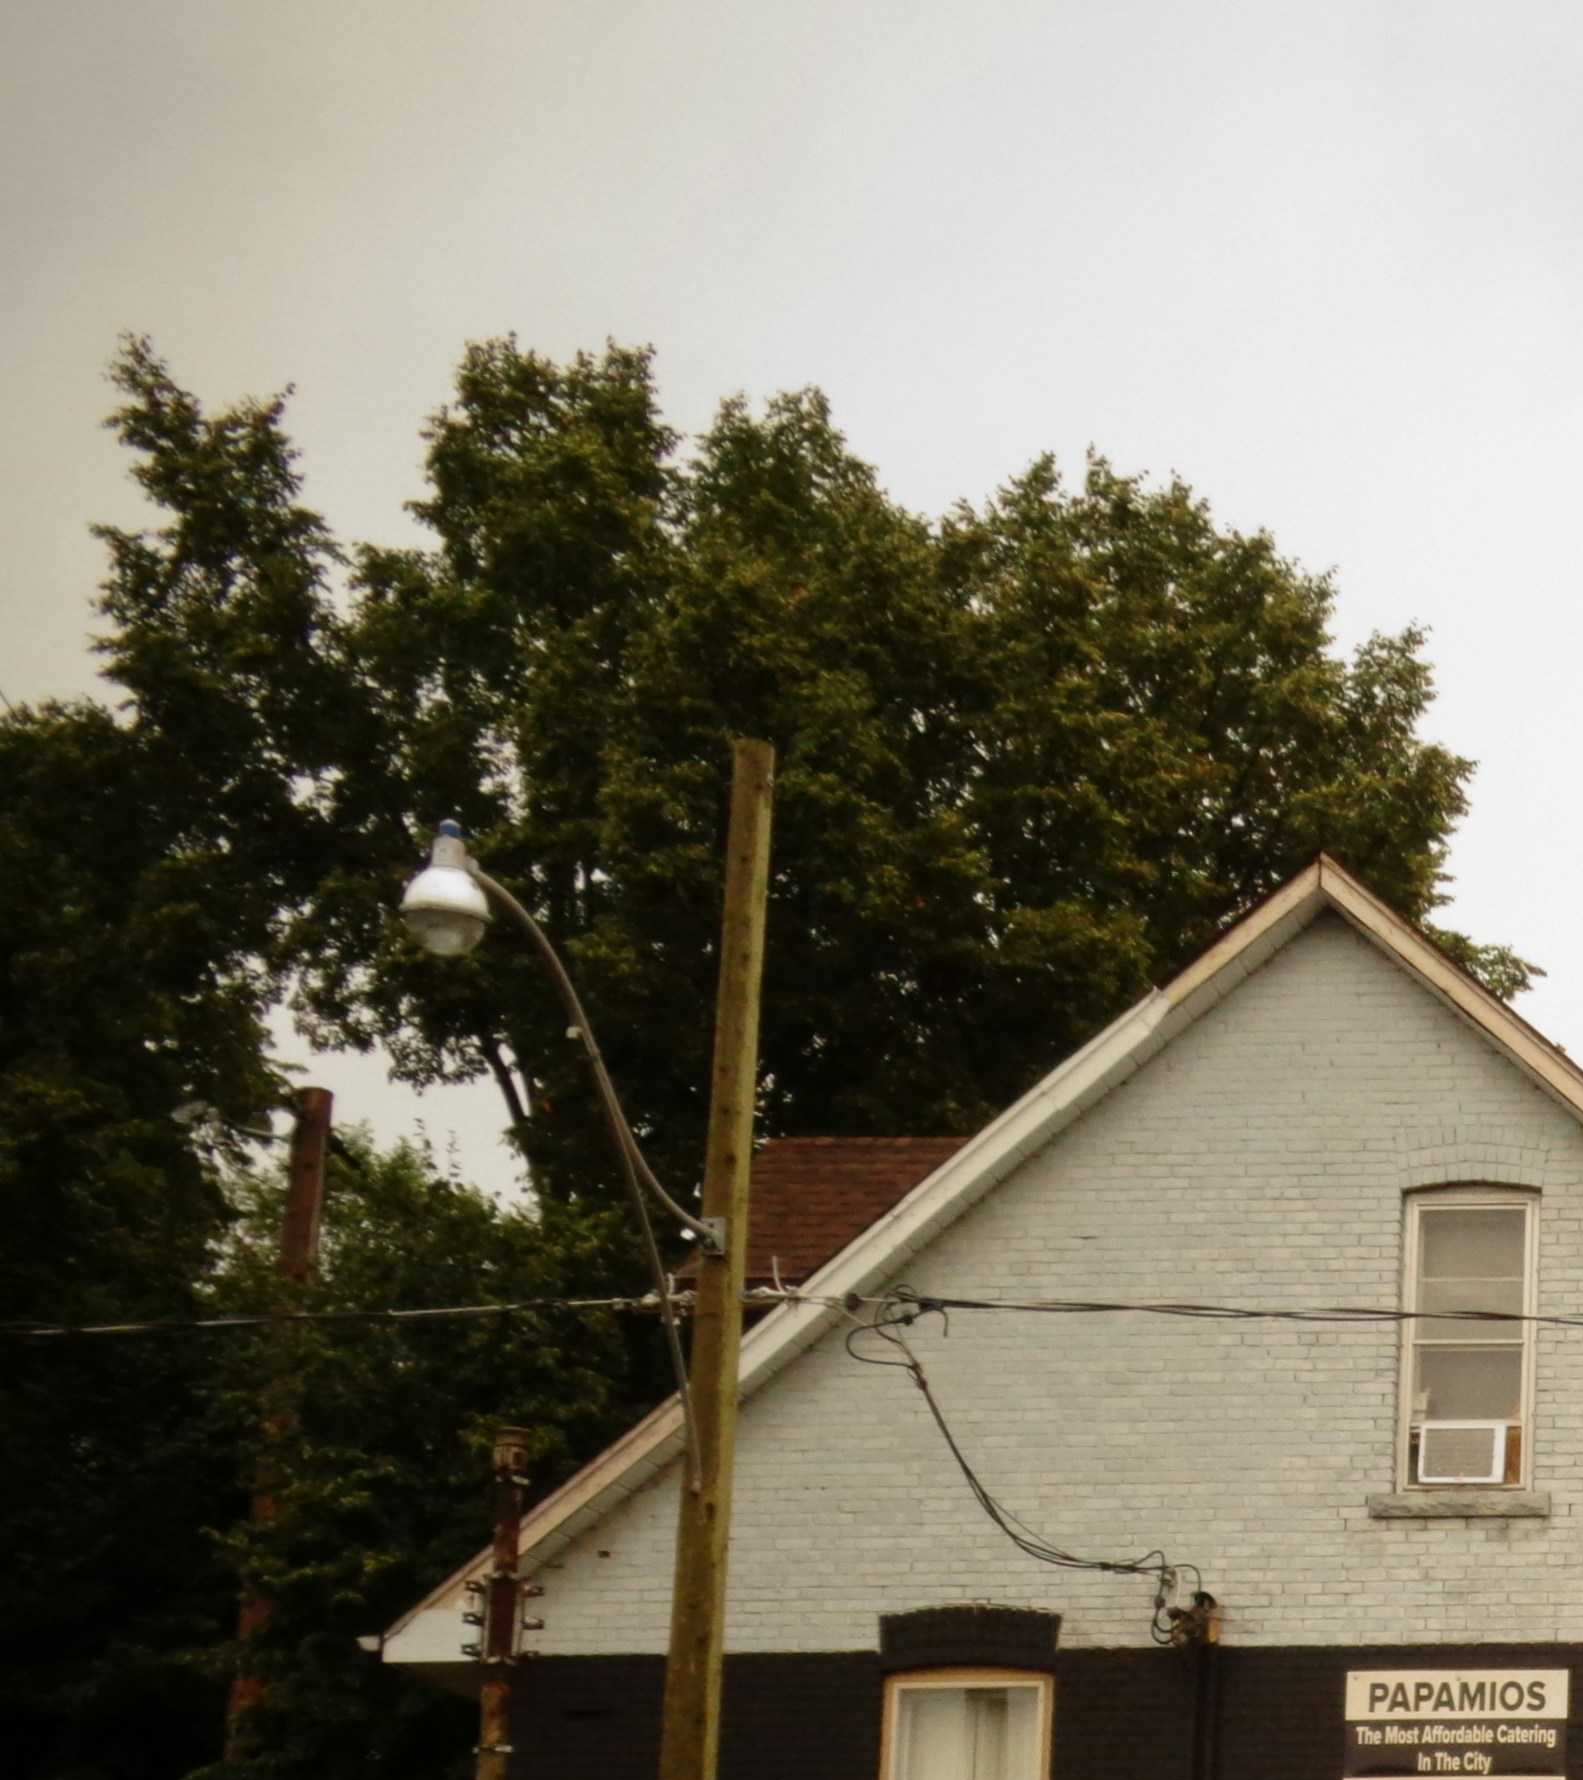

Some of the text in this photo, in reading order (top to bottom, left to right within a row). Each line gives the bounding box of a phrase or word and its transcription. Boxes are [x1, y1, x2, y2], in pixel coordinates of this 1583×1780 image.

[1368, 1681, 1547, 1713] PAPAMIOS
[1356, 1724, 1556, 1748] The Most Affordable Catering
[1418, 1752, 1492, 1775] In The City
